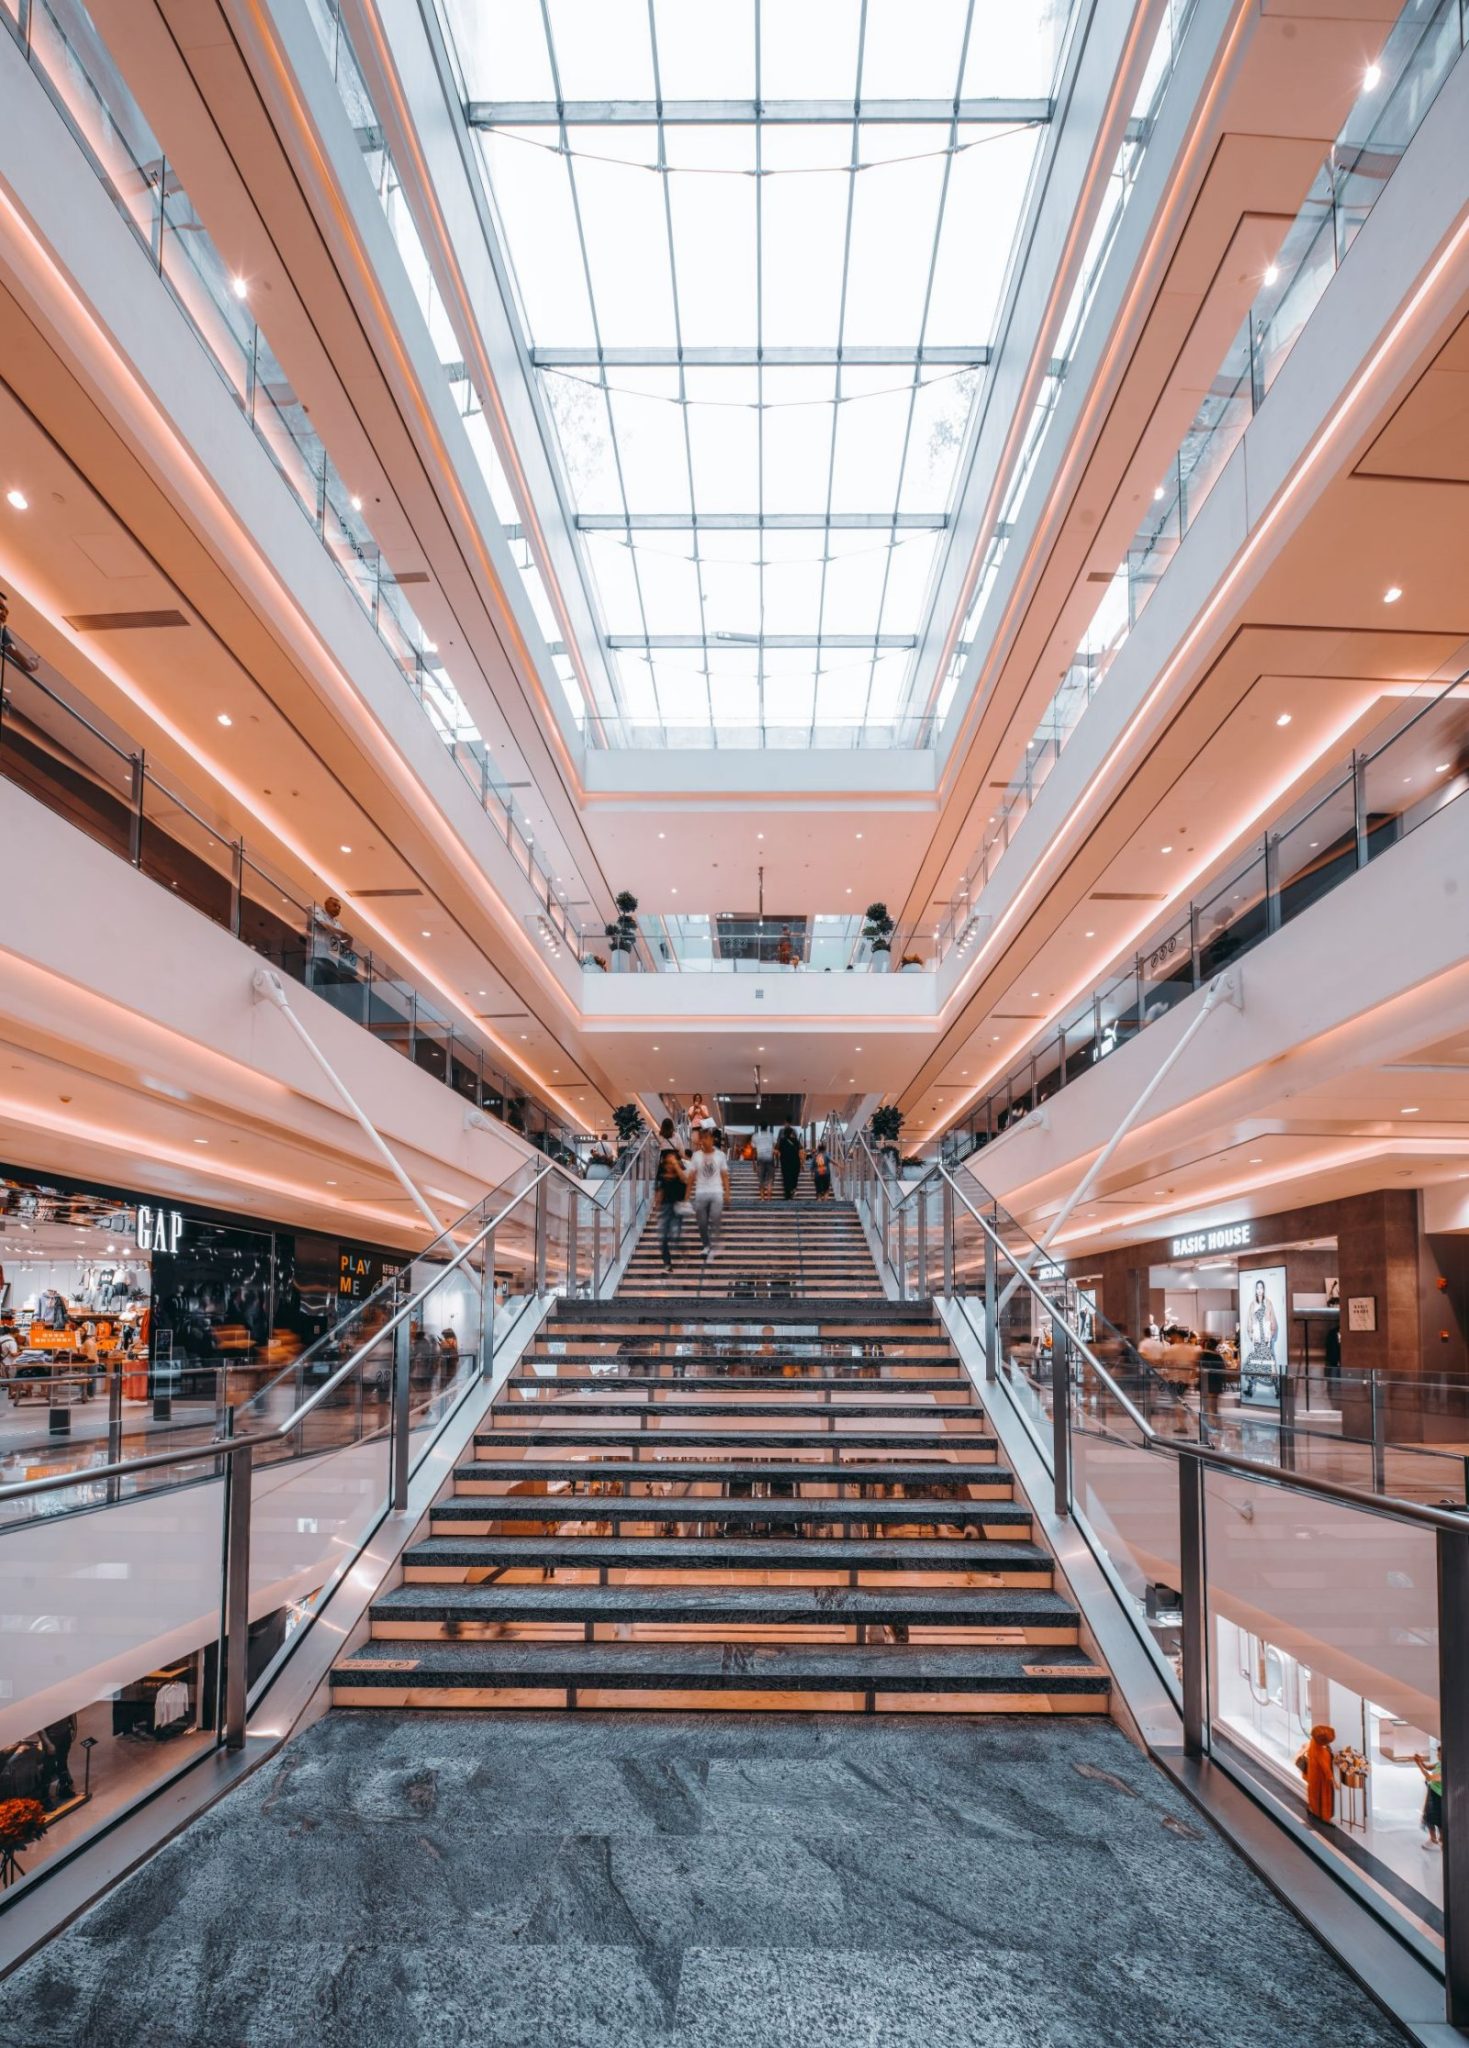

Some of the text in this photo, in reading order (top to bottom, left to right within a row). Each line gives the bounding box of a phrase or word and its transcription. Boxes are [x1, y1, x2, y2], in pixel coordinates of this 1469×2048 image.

[138, 1208, 182, 1253] GAP
[1173, 1225, 1250, 1256] BASIC HOUSE
[341, 1255, 371, 1275] PLAY
[340, 1276, 360, 1295] ME
